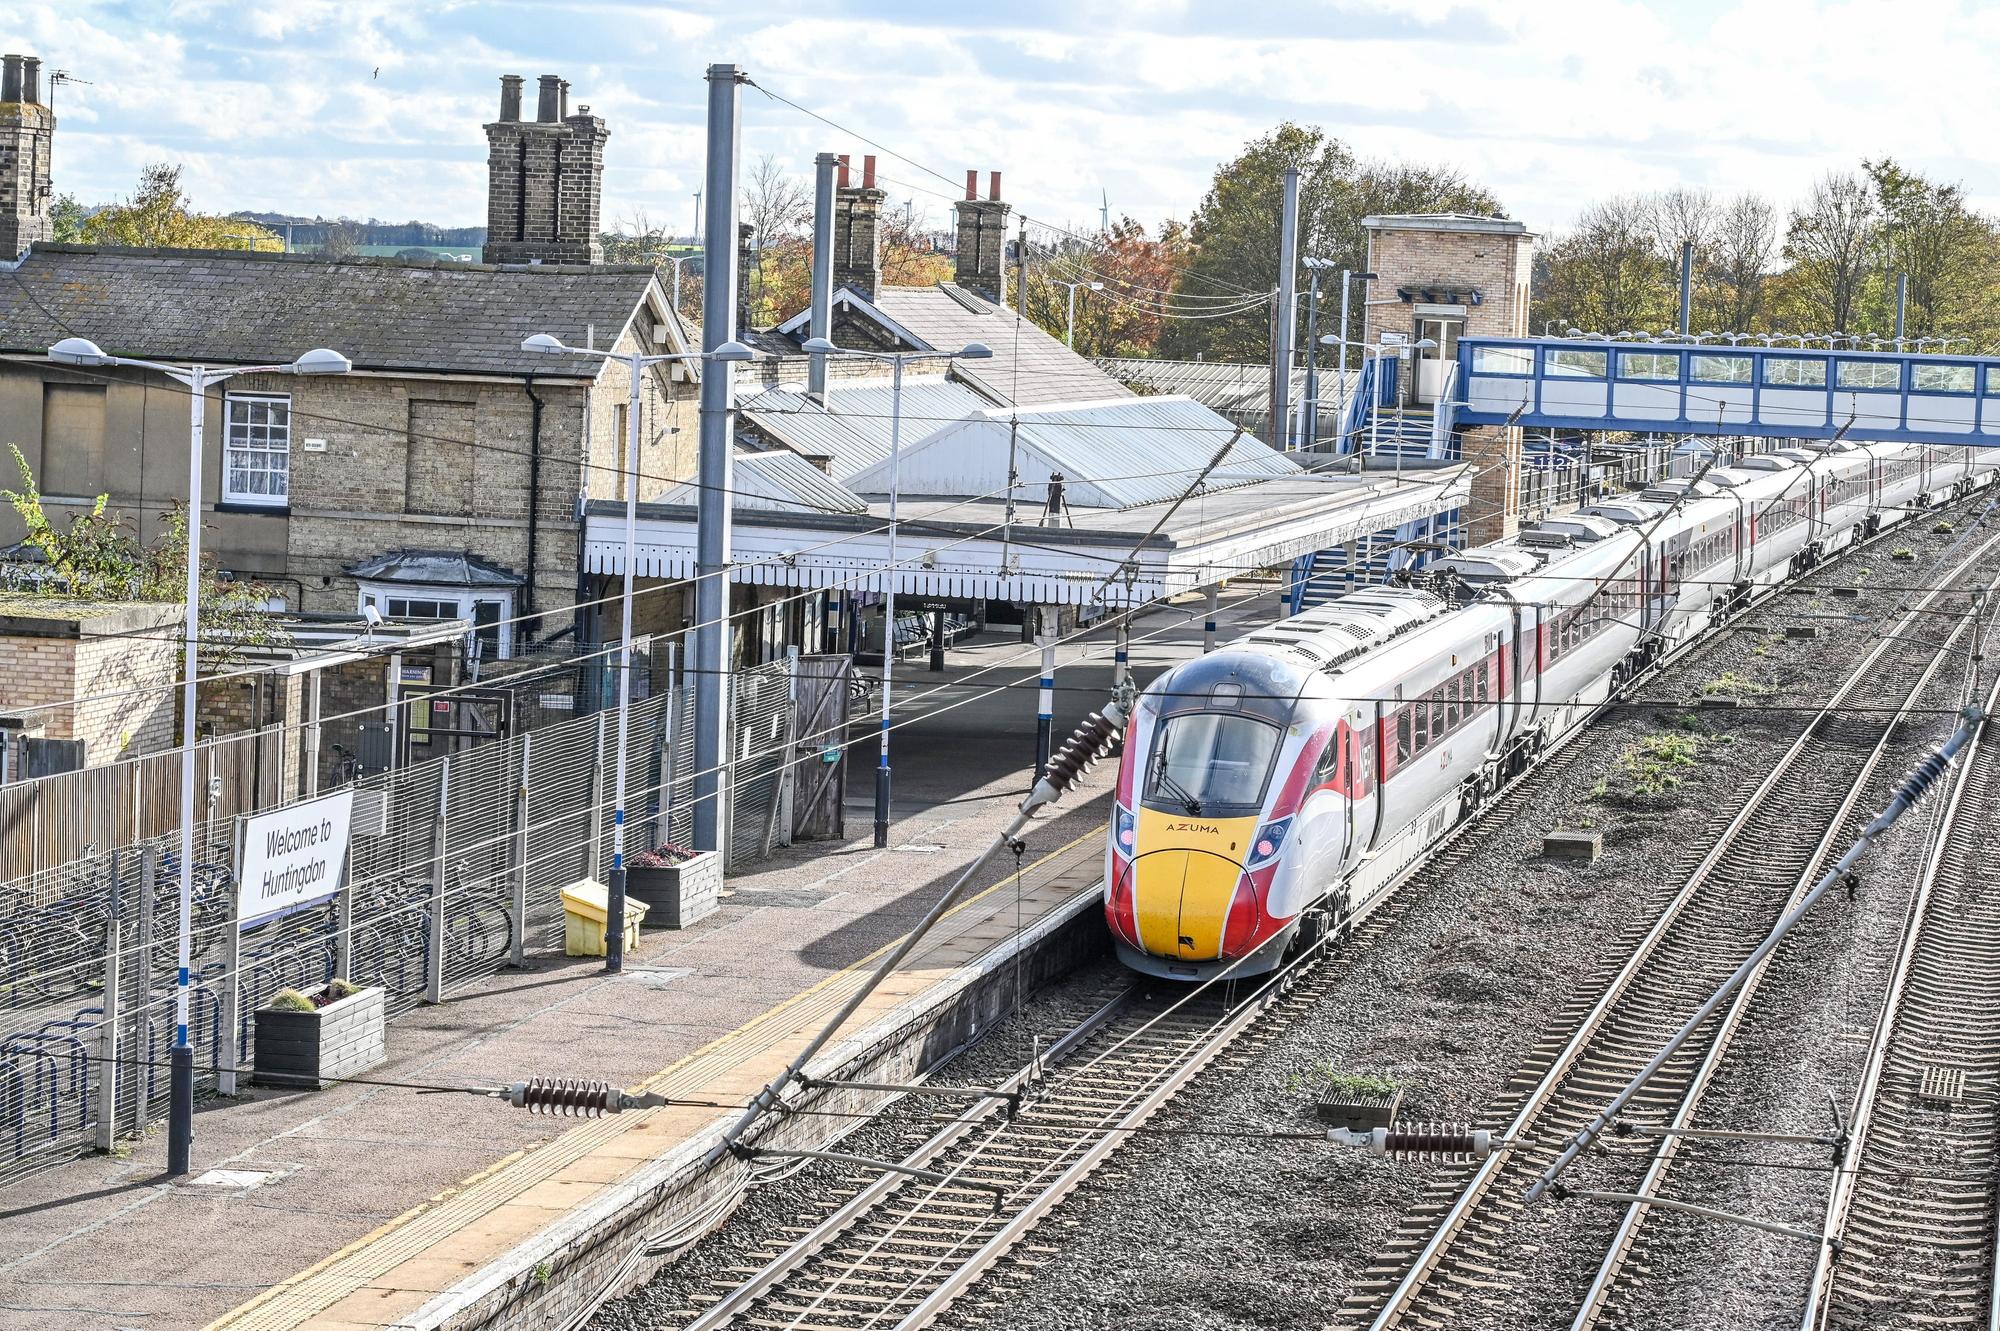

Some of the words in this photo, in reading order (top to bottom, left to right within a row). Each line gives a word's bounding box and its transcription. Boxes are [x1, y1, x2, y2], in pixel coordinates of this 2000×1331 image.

[1556, 458, 1564, 470] 2
[267, 825, 318, 859] Welcome
[320, 818, 331, 842] to
[1166, 824, 1219, 834] AZUMA
[261, 857, 326, 899] Huntingdon
